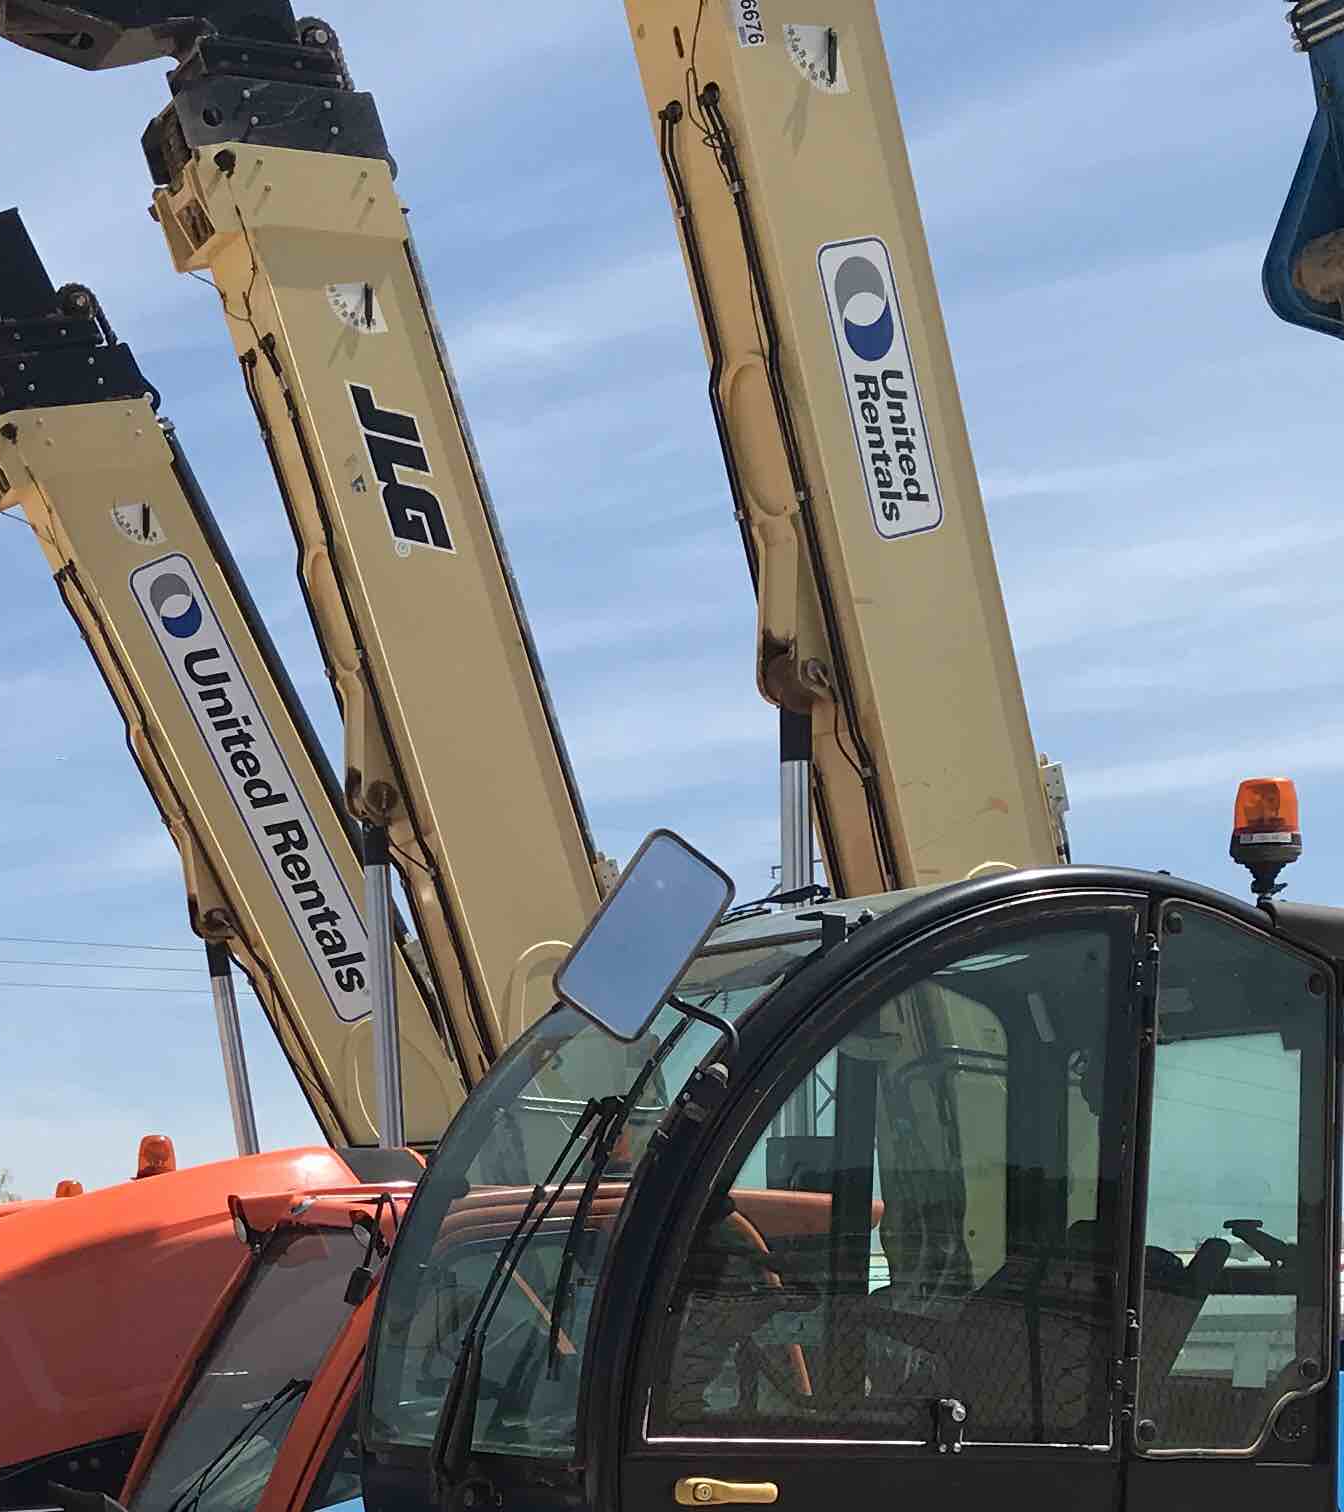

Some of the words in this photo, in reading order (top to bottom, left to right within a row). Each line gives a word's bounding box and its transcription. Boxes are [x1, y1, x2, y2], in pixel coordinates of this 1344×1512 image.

[346, 381, 455, 553] JLG
[853, 373, 903, 522] Rentals
[880, 368, 930, 502] United
[184, 648, 288, 809] United
[263, 819, 366, 992] Rentals
